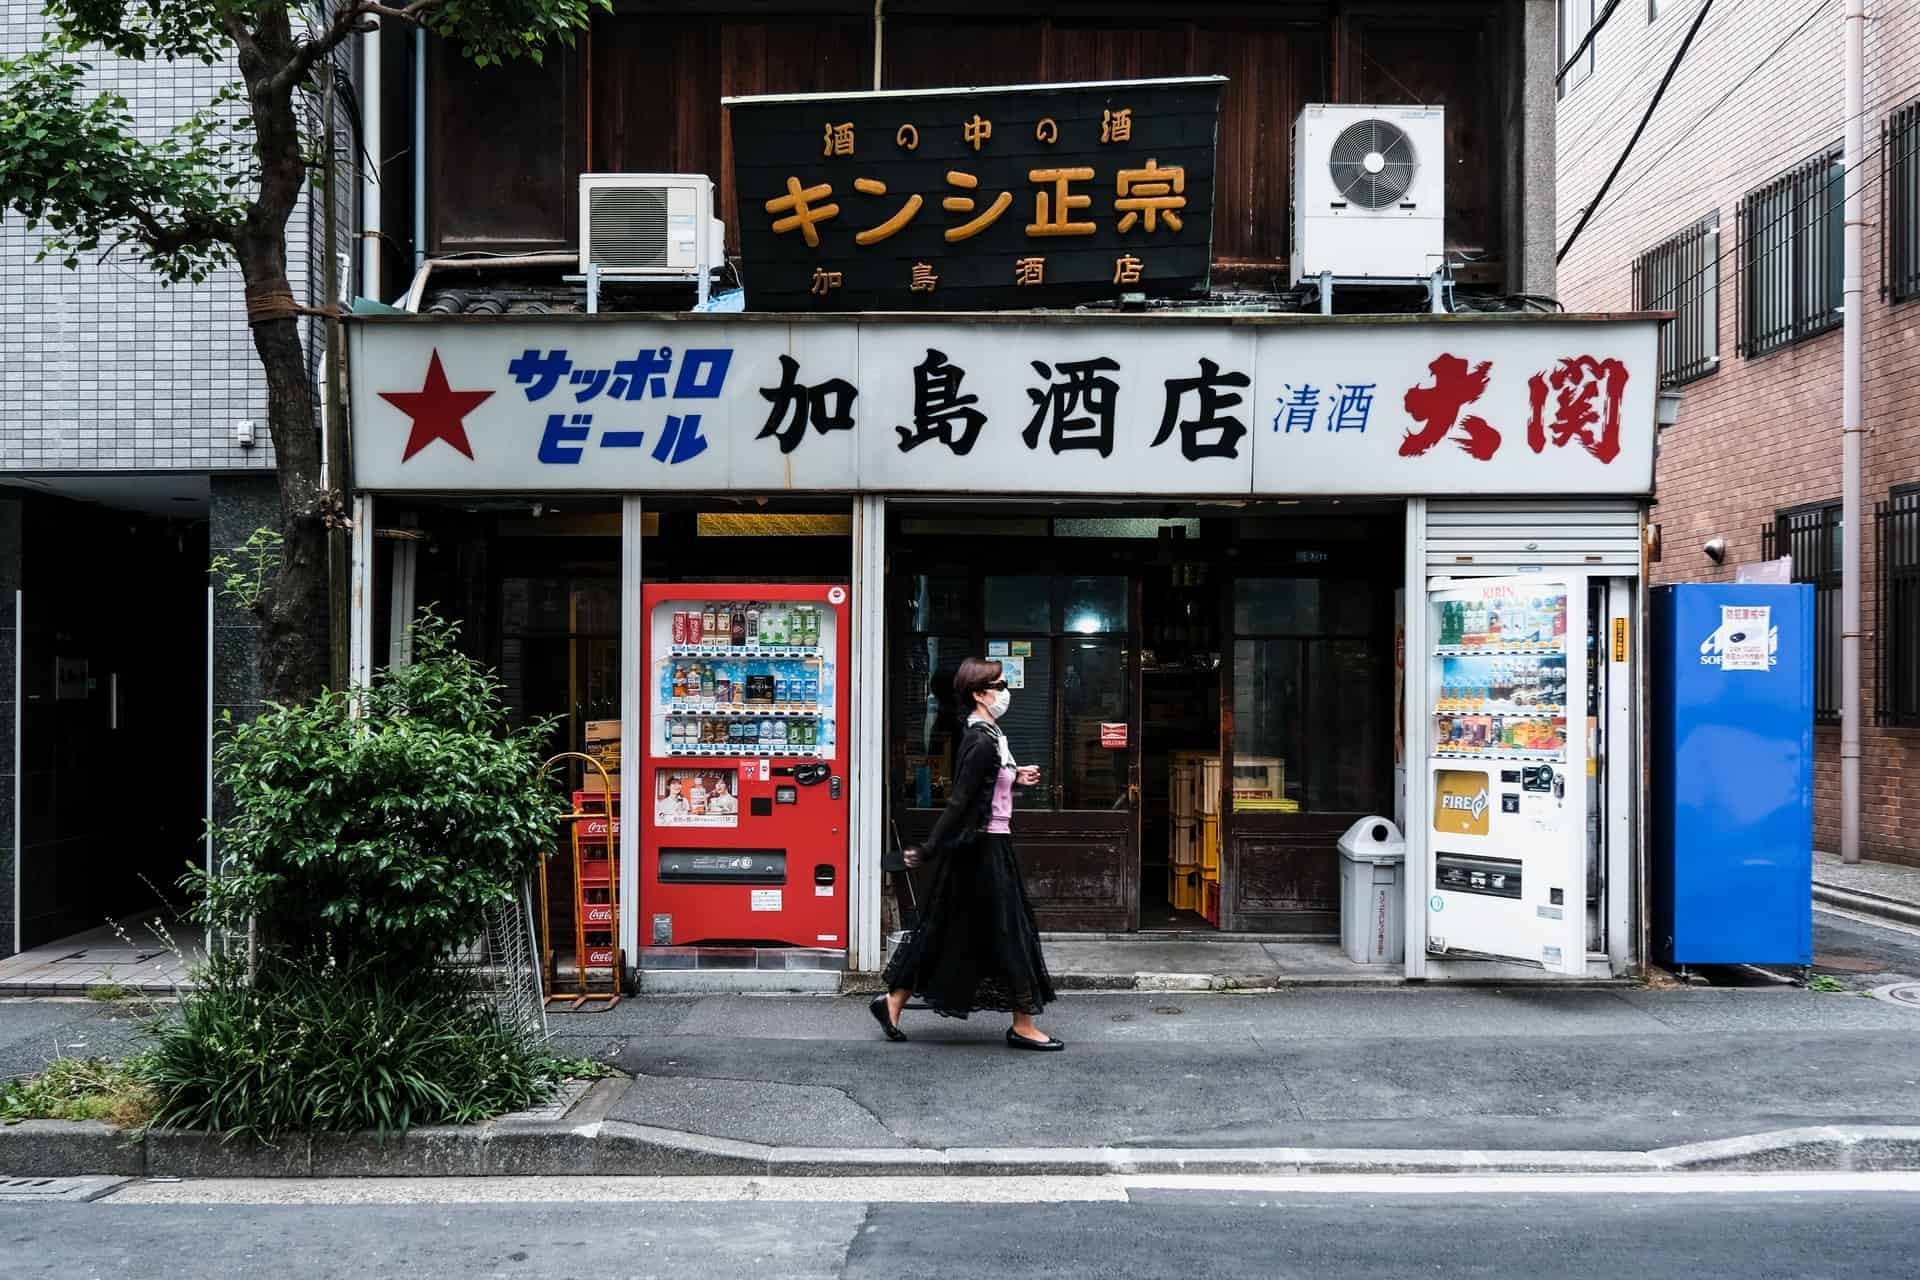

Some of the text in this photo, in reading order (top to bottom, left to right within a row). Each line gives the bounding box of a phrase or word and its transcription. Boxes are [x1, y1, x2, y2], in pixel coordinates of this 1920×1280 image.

[823, 108, 1132, 157] 酒の中の酒
[765, 158, 1187, 248] キンシ正宗
[811, 254, 1144, 296] 加島酒店
[508, 345, 734, 403] サッポロ
[755, 347, 1251, 461] 加島酒店
[1272, 382, 1377, 434] 清酒
[1398, 352, 1630, 465] 大関
[537, 414, 708, 465] ビール
[1441, 794, 1473, 810] FIRE
